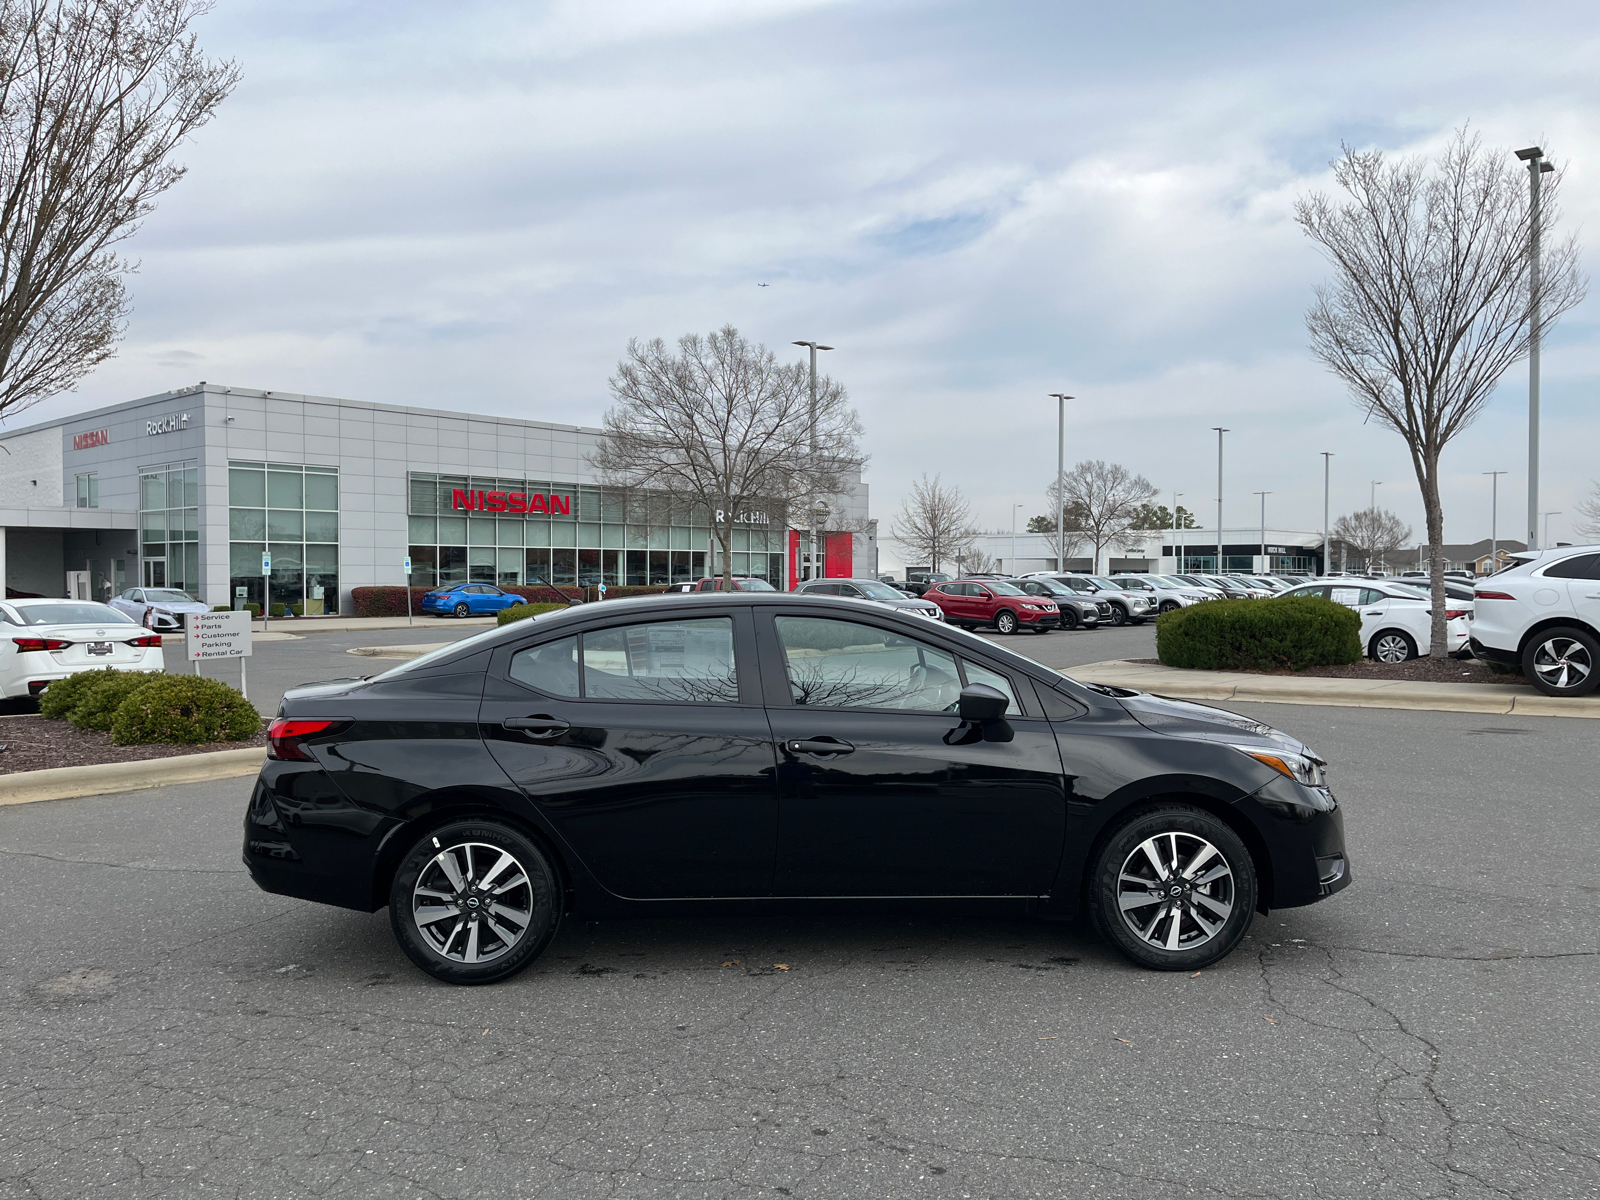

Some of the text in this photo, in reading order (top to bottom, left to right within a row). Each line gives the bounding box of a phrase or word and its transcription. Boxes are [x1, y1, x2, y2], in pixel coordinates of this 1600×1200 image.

[146, 417, 168, 435] Rock
[73, 429, 109, 450] NISSAN
[452, 488, 570, 515] NISSAN
